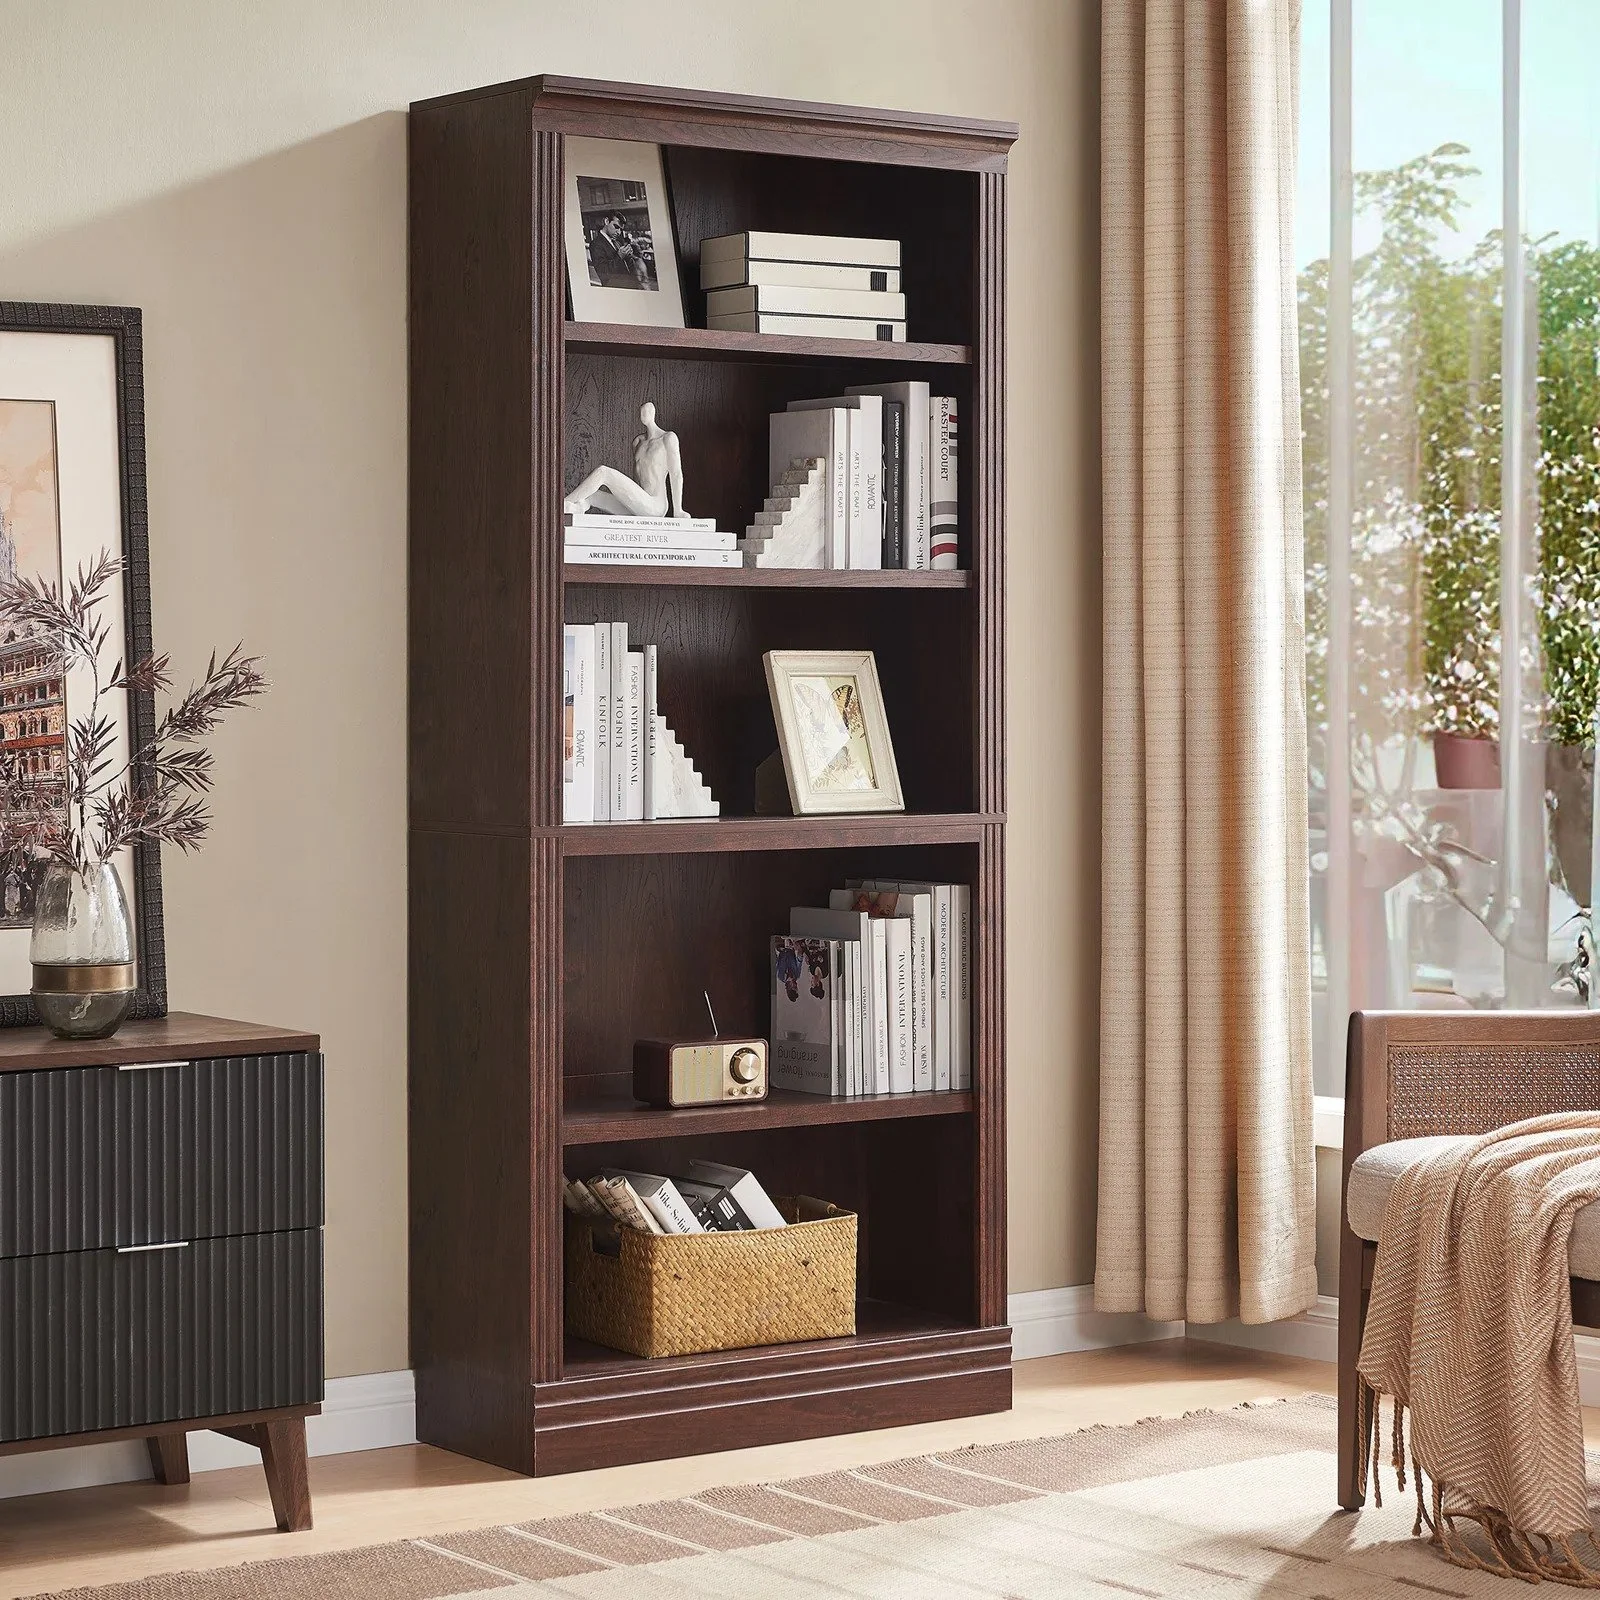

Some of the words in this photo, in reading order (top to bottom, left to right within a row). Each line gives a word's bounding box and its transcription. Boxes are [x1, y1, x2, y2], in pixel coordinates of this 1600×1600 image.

[941, 397, 949, 444] CRASTER
[867, 473, 876, 510] ROMANTIC
[604, 533, 642, 542] GREATEST
[646, 534, 669, 543] RIVER
[916, 503, 924, 544] Selinker
[588, 552, 642, 560] ARCHITECTURAL
[643, 552, 697, 561] CONTEMPORARY
[916, 547, 924, 570] Mike
[599, 695, 607, 749] KINFOLK
[616, 695, 624, 748] KINFOLK
[576, 729, 585, 768] ROMANTIC
[630, 705, 638, 786] INTERNATIONAL
[898, 951, 906, 1028] INTERNATIONAL
[777, 1046, 818, 1063] arranging
[899, 1034, 907, 1067] FASHION
[920, 1045, 928, 1075] FASHION
[777, 1063, 804, 1079] flower
[657, 1187, 672, 1209] Mike
